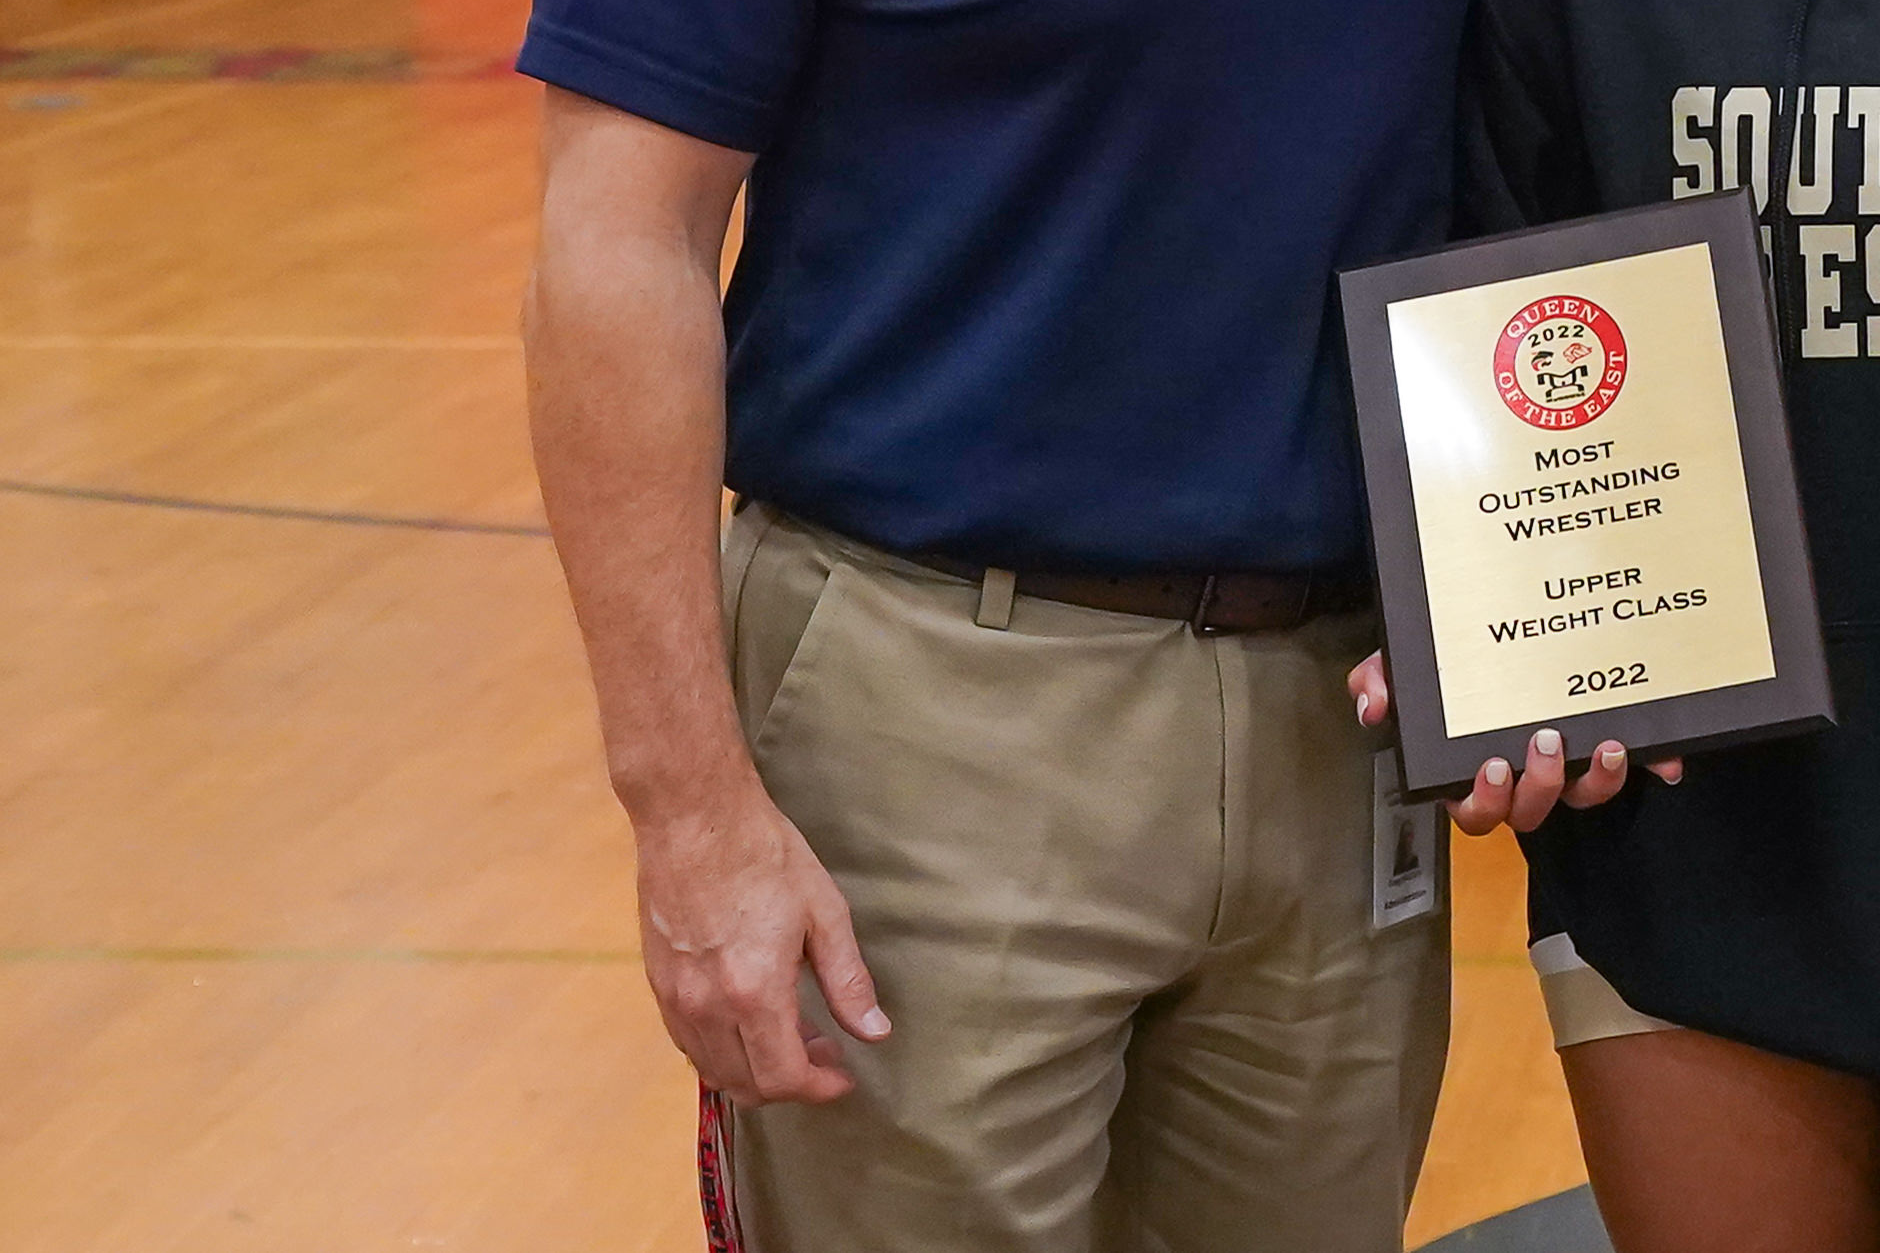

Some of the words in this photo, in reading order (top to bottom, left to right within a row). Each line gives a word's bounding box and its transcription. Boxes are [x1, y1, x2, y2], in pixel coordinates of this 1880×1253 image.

[1507, 299, 1599, 338] QUEEN
[1528, 325, 1585, 348] 2022
[1499, 372, 1523, 402] OF
[1523, 402, 1577, 427] THE
[1584, 350, 1625, 418] EAST
[1534, 440, 1615, 471] MOST
[1479, 462, 1680, 514] OUTSTANDING
[1504, 497, 1662, 542] WRESTLER
[1543, 567, 1643, 600] UPPER
[1488, 607, 1604, 643] WEIGHT
[1612, 588, 1708, 620] CLASS
[1566, 662, 1649, 696] 2022
